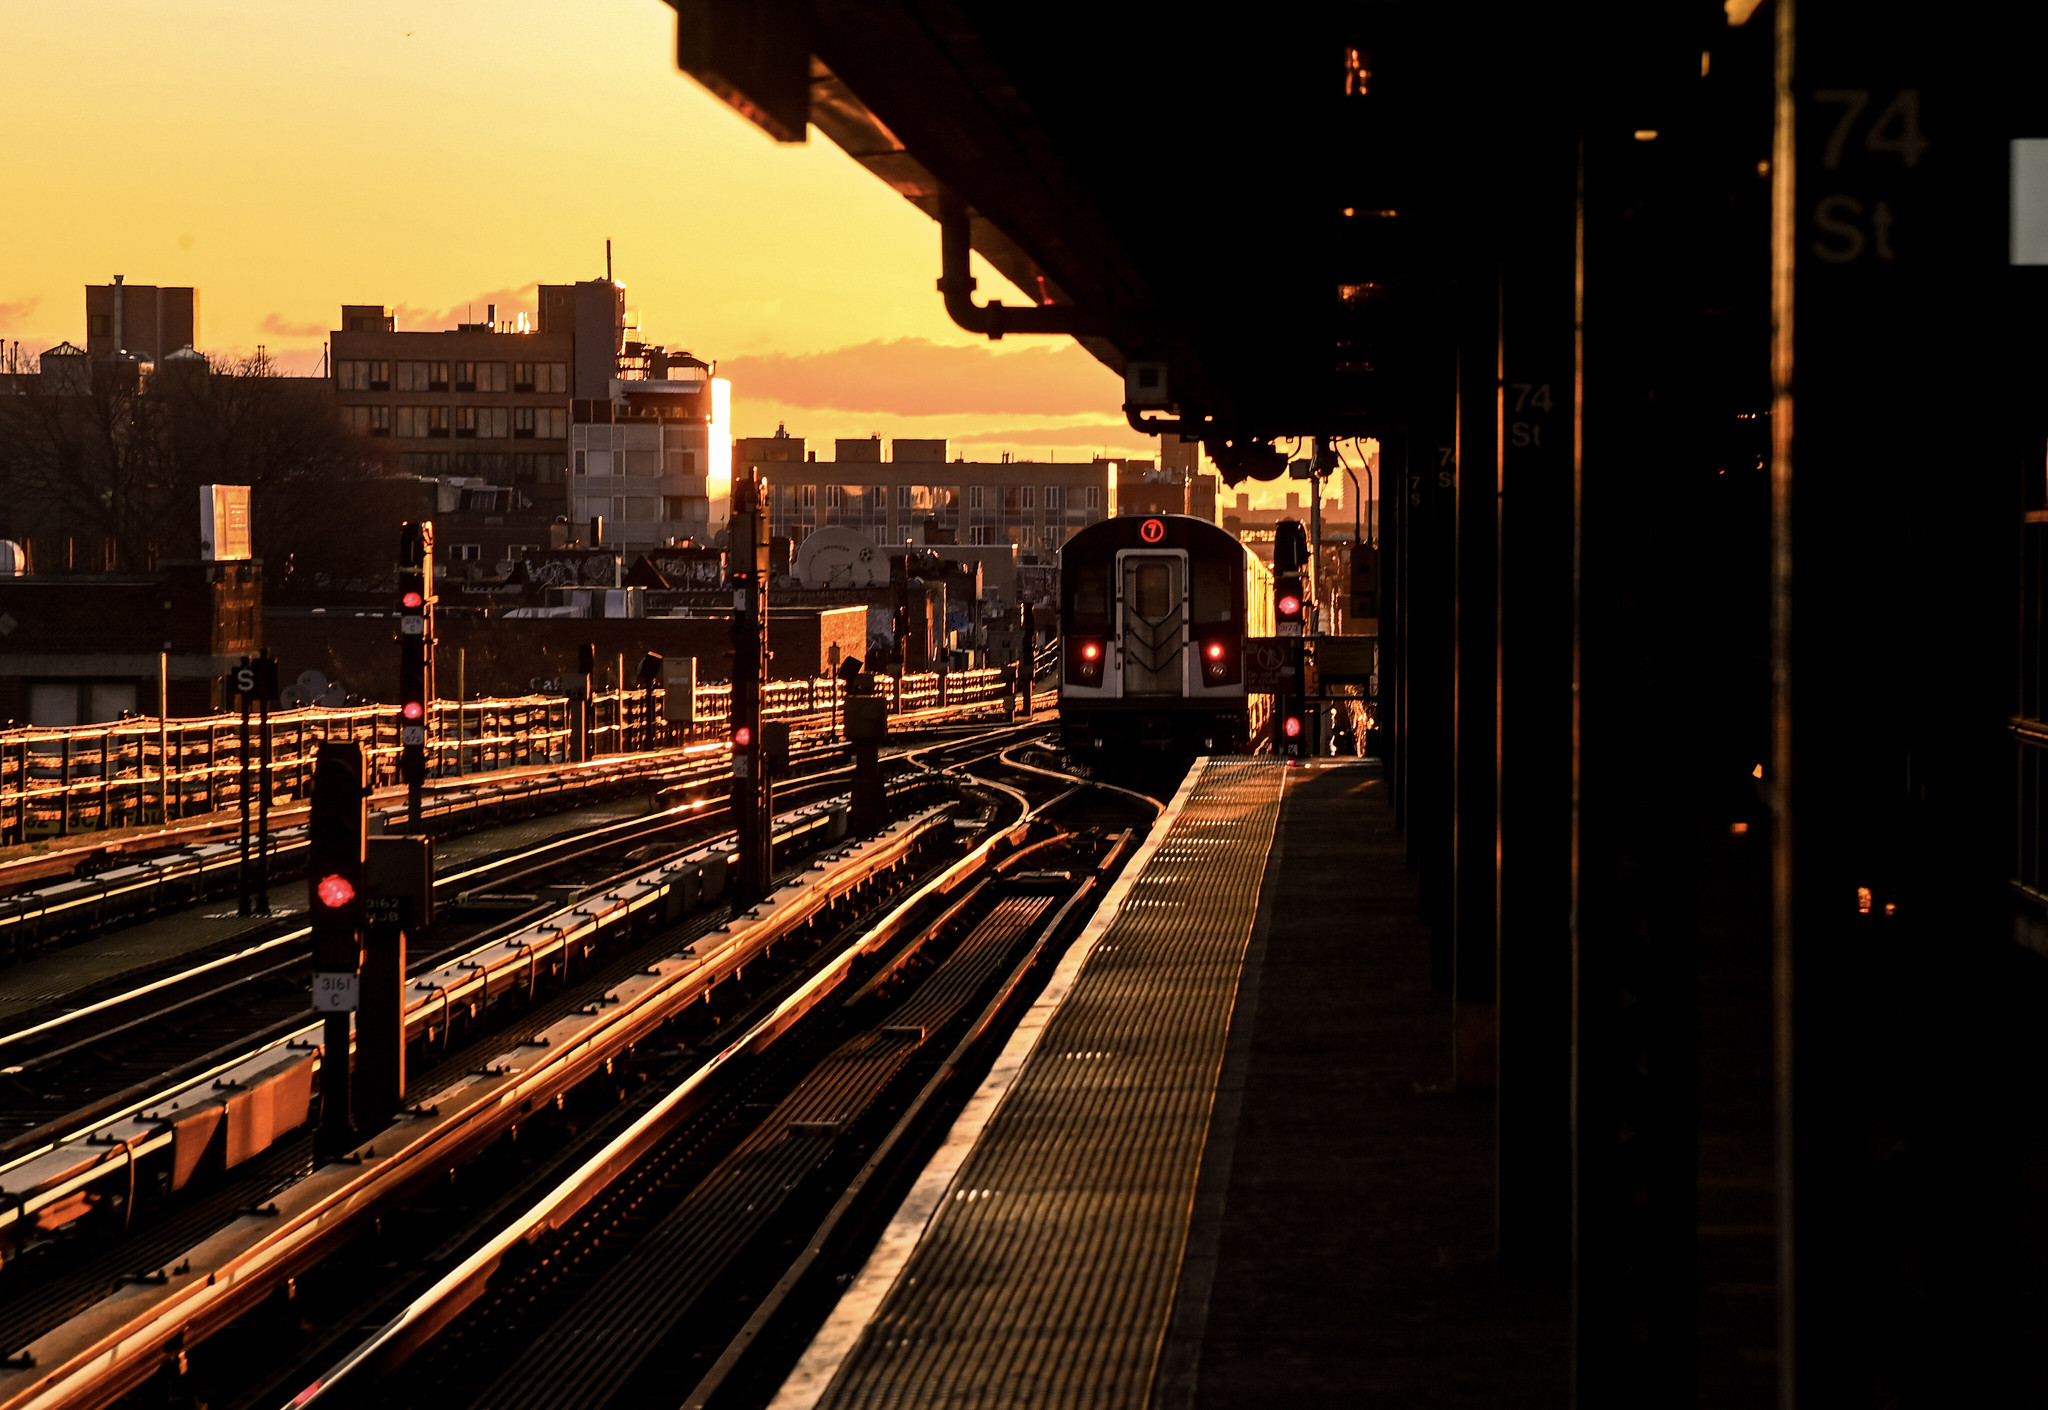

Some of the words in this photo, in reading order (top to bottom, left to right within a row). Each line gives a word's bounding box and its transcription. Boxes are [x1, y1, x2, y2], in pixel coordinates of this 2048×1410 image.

[1811, 87, 1932, 170] 74
[1811, 193, 1896, 264] St
[1510, 382, 1555, 413] 74
[1510, 421, 1541, 447] St
[237, 669, 255, 691] S
[321, 977, 350, 991] 3161
[331, 993, 340, 1007] C
